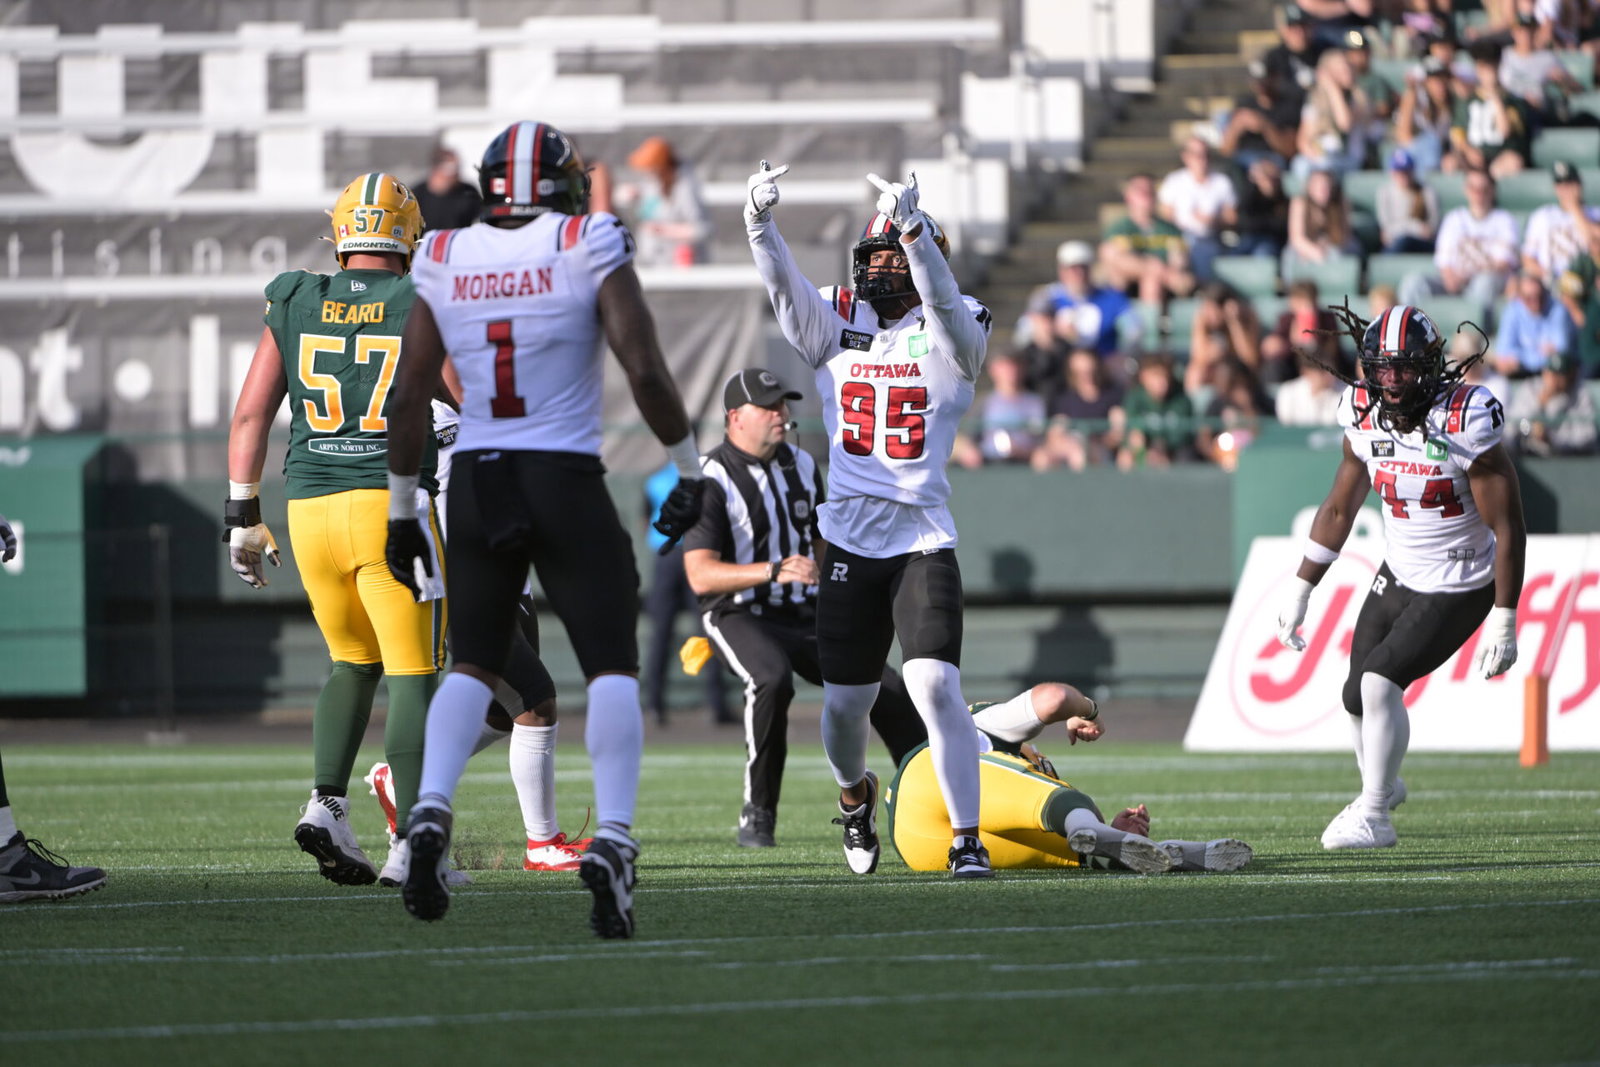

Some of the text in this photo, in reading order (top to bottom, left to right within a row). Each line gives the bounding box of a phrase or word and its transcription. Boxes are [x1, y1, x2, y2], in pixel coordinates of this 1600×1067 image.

[354, 206, 385, 234] 57
[343, 241, 399, 250] EDMONTON
[451, 266, 553, 301] MORGAN
[321, 300, 385, 324] BEARD
[844, 331, 871, 343] TOONIE
[849, 340, 862, 349] BET
[487, 318, 528, 419] 1
[850, 362, 922, 378] OTTAWA
[299, 333, 403, 434] 57
[841, 381, 928, 460] 95
[318, 443, 381, 452] ARPI'S NORTH INC.
[1379, 460, 1443, 476] OTTAWA
[1373, 468, 1465, 520] 44
[830, 561, 849, 582] R
[316, 796, 345, 821] NIKE
